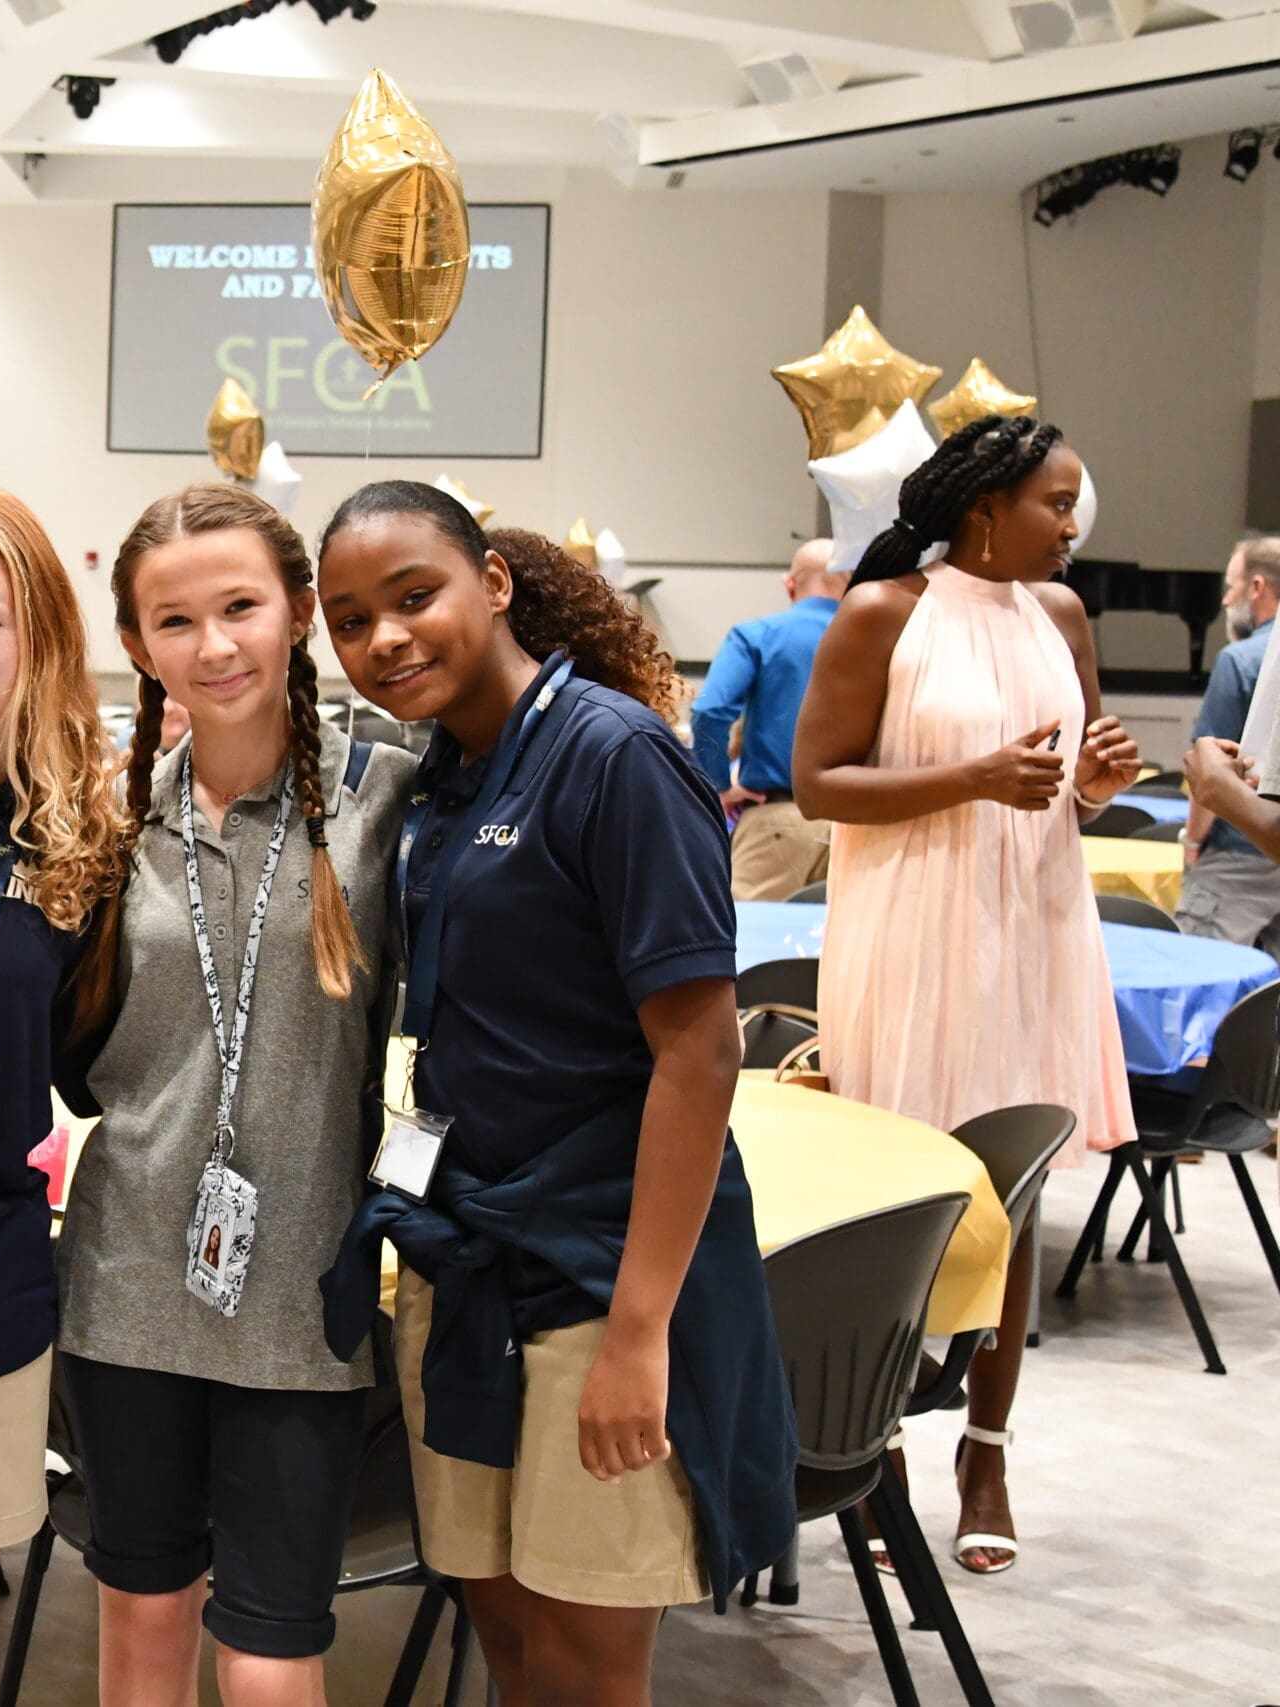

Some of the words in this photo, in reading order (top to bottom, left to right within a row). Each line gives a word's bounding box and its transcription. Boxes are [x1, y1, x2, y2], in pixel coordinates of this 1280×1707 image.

[149, 244, 297, 268] WELCOME
[221, 274, 285, 299] AND
[216, 335, 432, 412] SFCA
[474, 825, 519, 846] SFCA
[297, 879, 350, 907] SA
[208, 1201, 230, 1229] SFCA
